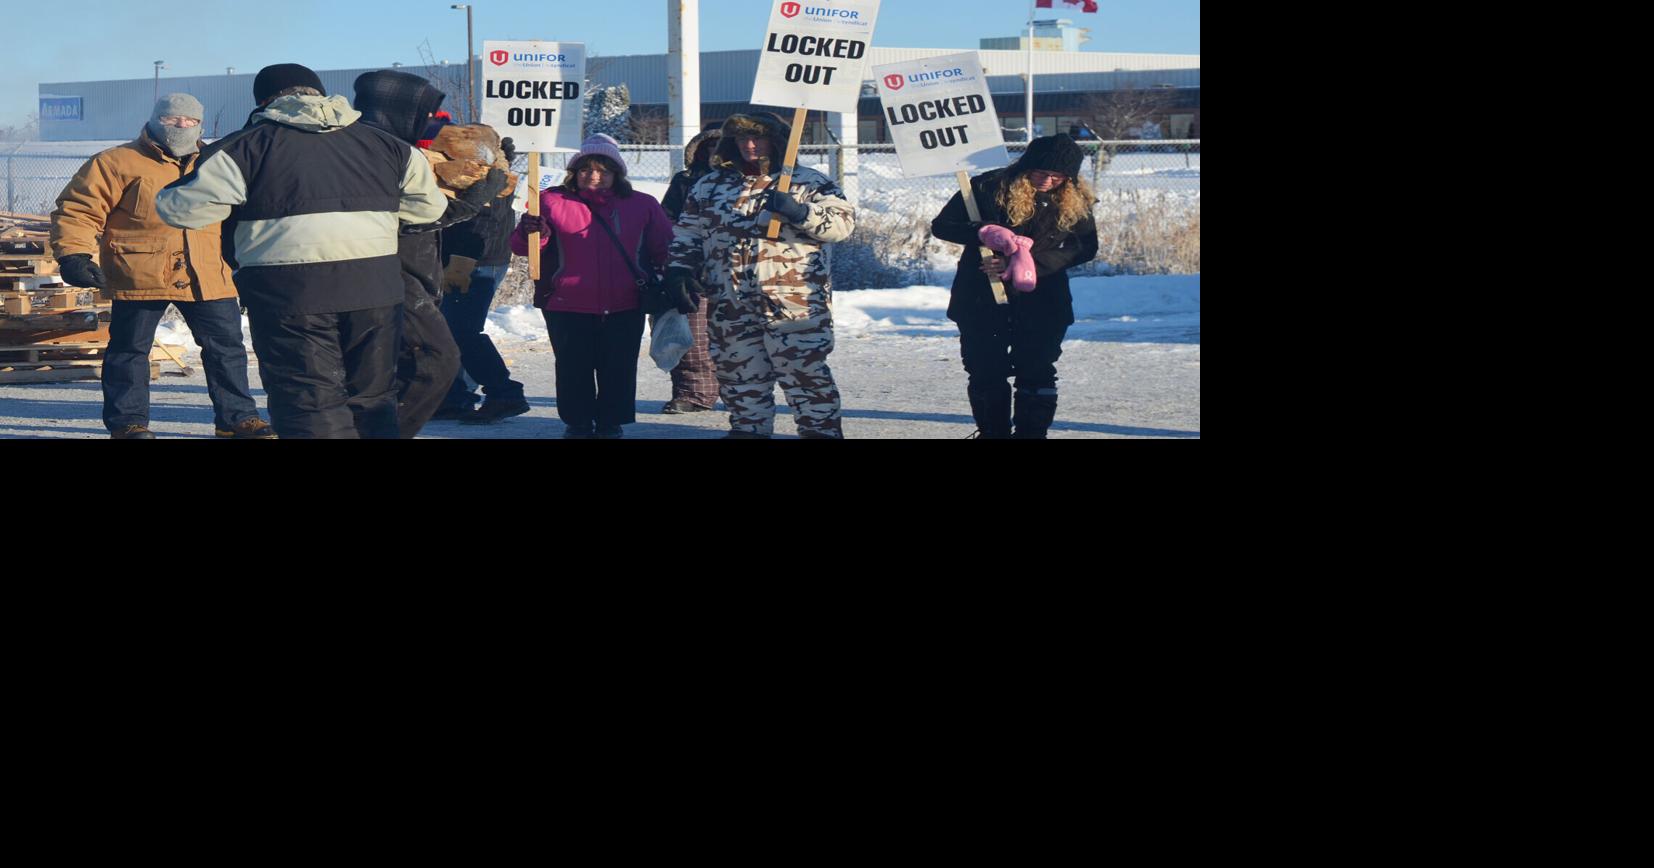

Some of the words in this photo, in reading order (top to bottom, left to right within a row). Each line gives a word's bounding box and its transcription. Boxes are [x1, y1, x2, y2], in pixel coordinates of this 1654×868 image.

[805, 7, 859, 19] UNIFOR
[767, 33, 865, 59] LOCKED
[513, 53, 566, 62] UNIFOR
[785, 63, 837, 85] OUT
[908, 68, 962, 82] UNIFOR
[486, 80, 580, 100] LOCKED
[508, 108, 556, 126] OUT
[887, 94, 986, 125] LOCKED
[920, 125, 968, 149] OUT
